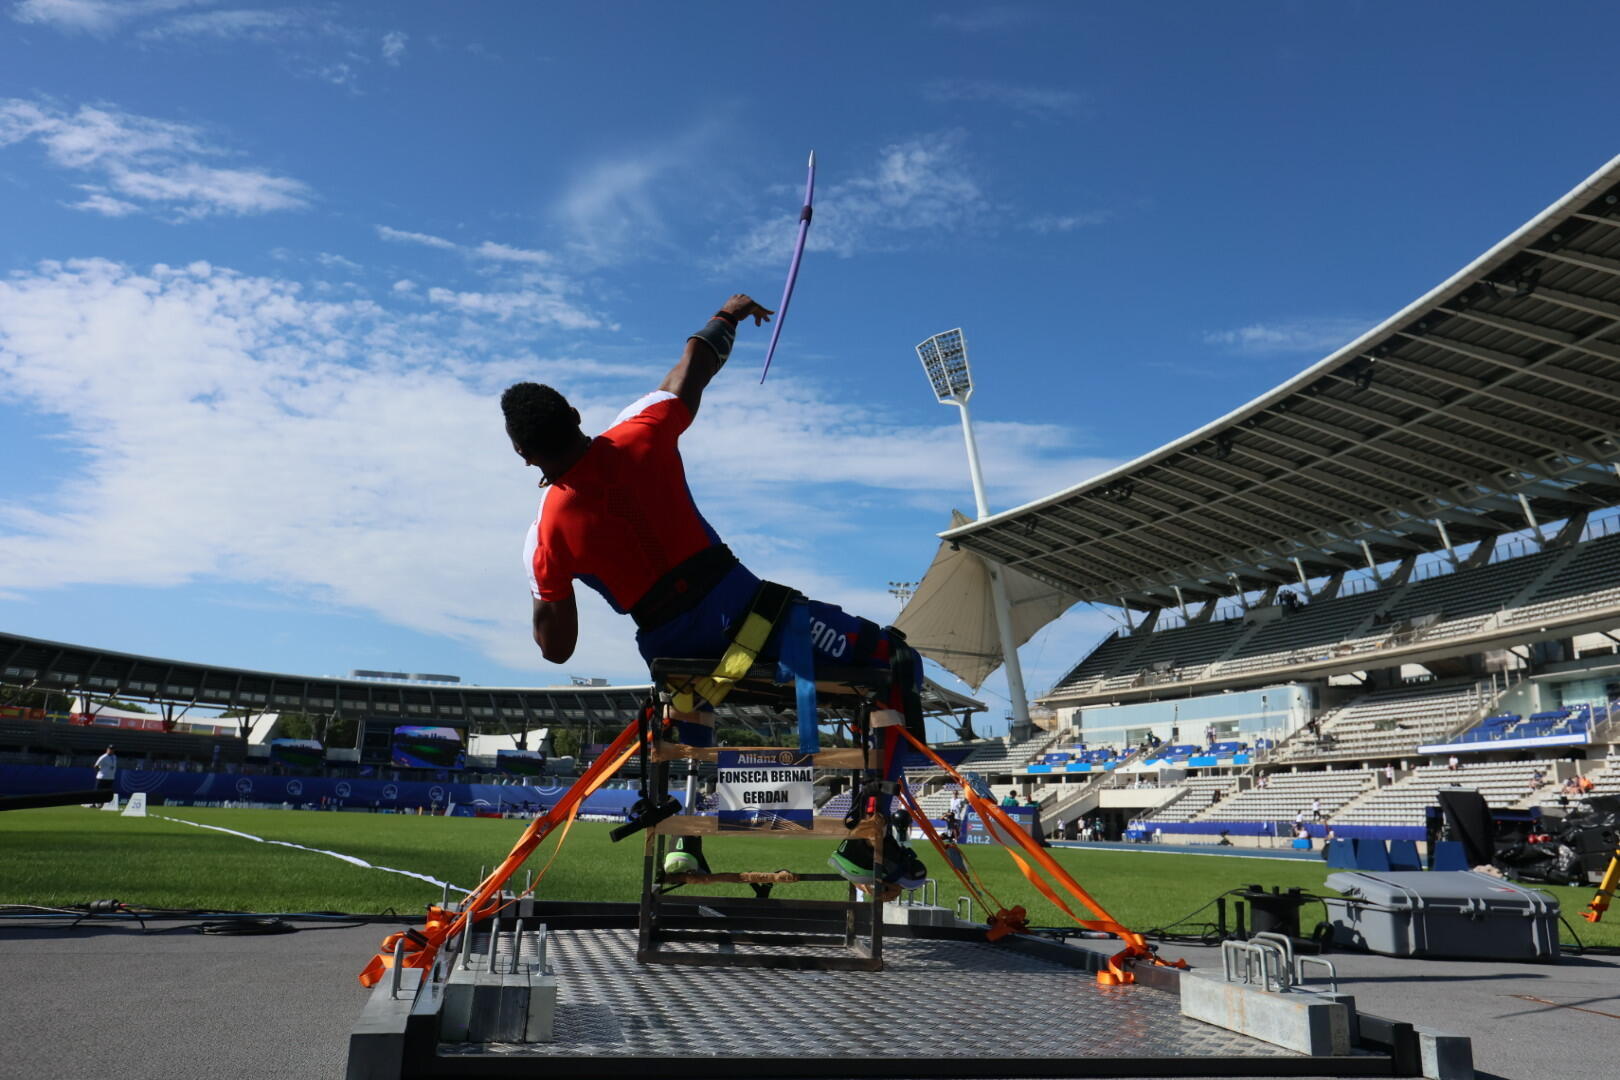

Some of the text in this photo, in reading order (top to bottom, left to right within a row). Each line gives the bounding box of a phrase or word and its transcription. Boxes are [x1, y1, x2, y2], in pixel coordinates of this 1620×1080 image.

[810, 616, 847, 658] CUB
[737, 753, 777, 764] Allianz
[720, 769, 812, 783] FONSECA BERNAL
[743, 790, 789, 804] GERDAN
